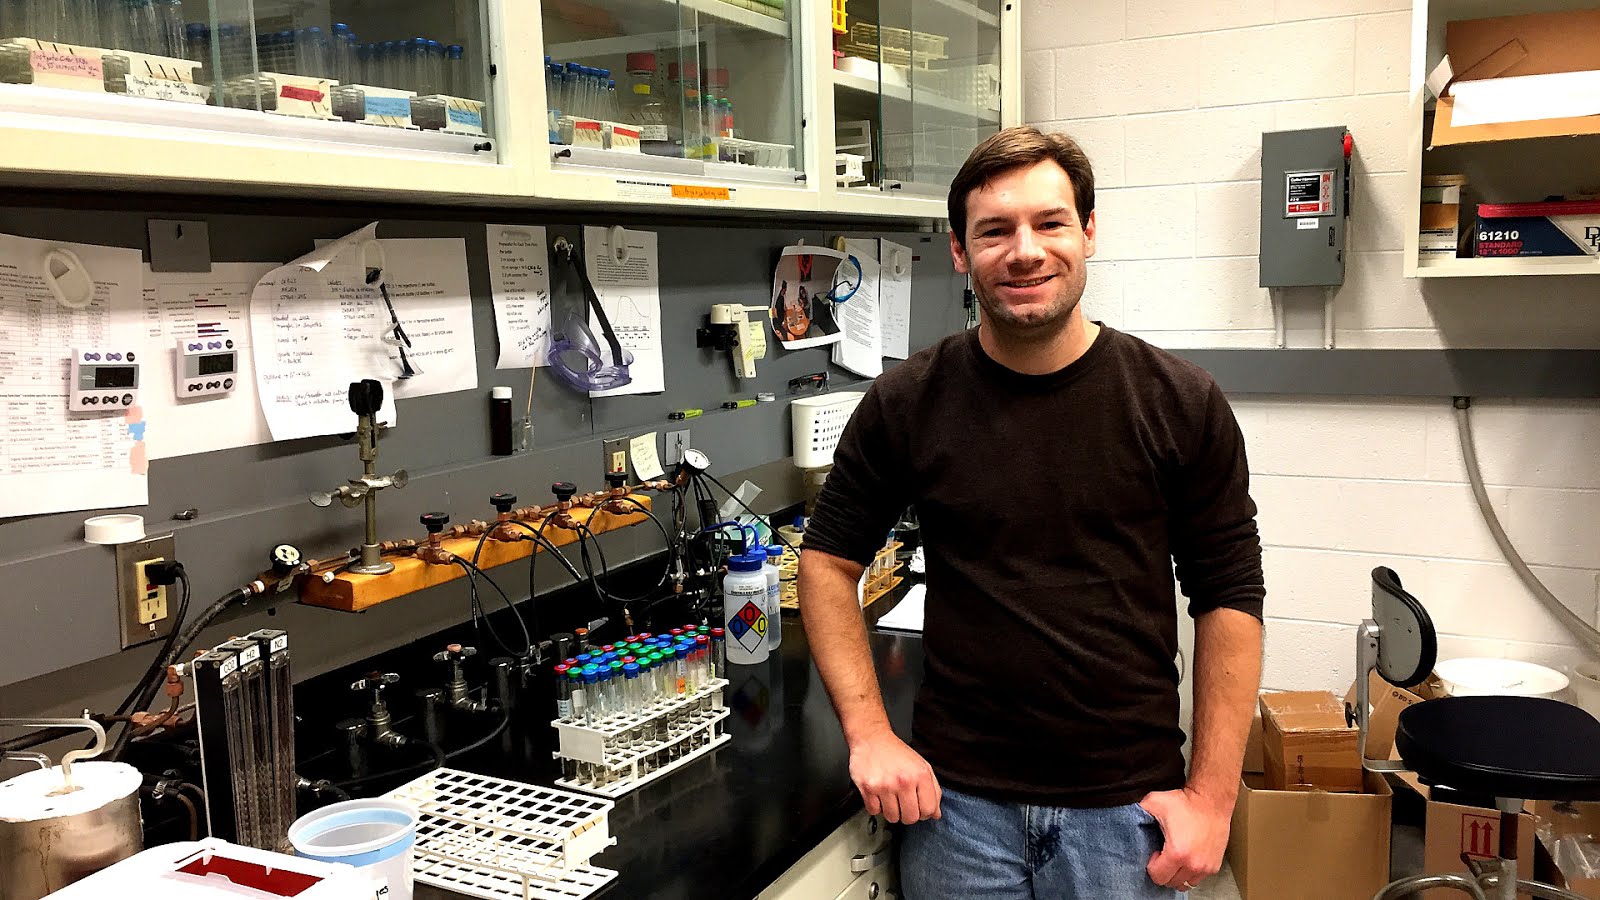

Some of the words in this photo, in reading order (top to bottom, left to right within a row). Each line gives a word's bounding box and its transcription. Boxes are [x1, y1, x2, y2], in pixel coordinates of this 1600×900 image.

[1323, 174, 1330, 182] ON
[1322, 202, 1330, 211] OFF
[1479, 230, 1519, 240] 61210
[1478, 241, 1523, 249] STANDARD
[744, 606, 755, 622] 0
[733, 619, 743, 634] 0
[757, 617, 766, 633] 0
[274, 638, 283, 649] N2
[246, 649, 256, 660] H2
[224, 660, 235, 673] CO2
